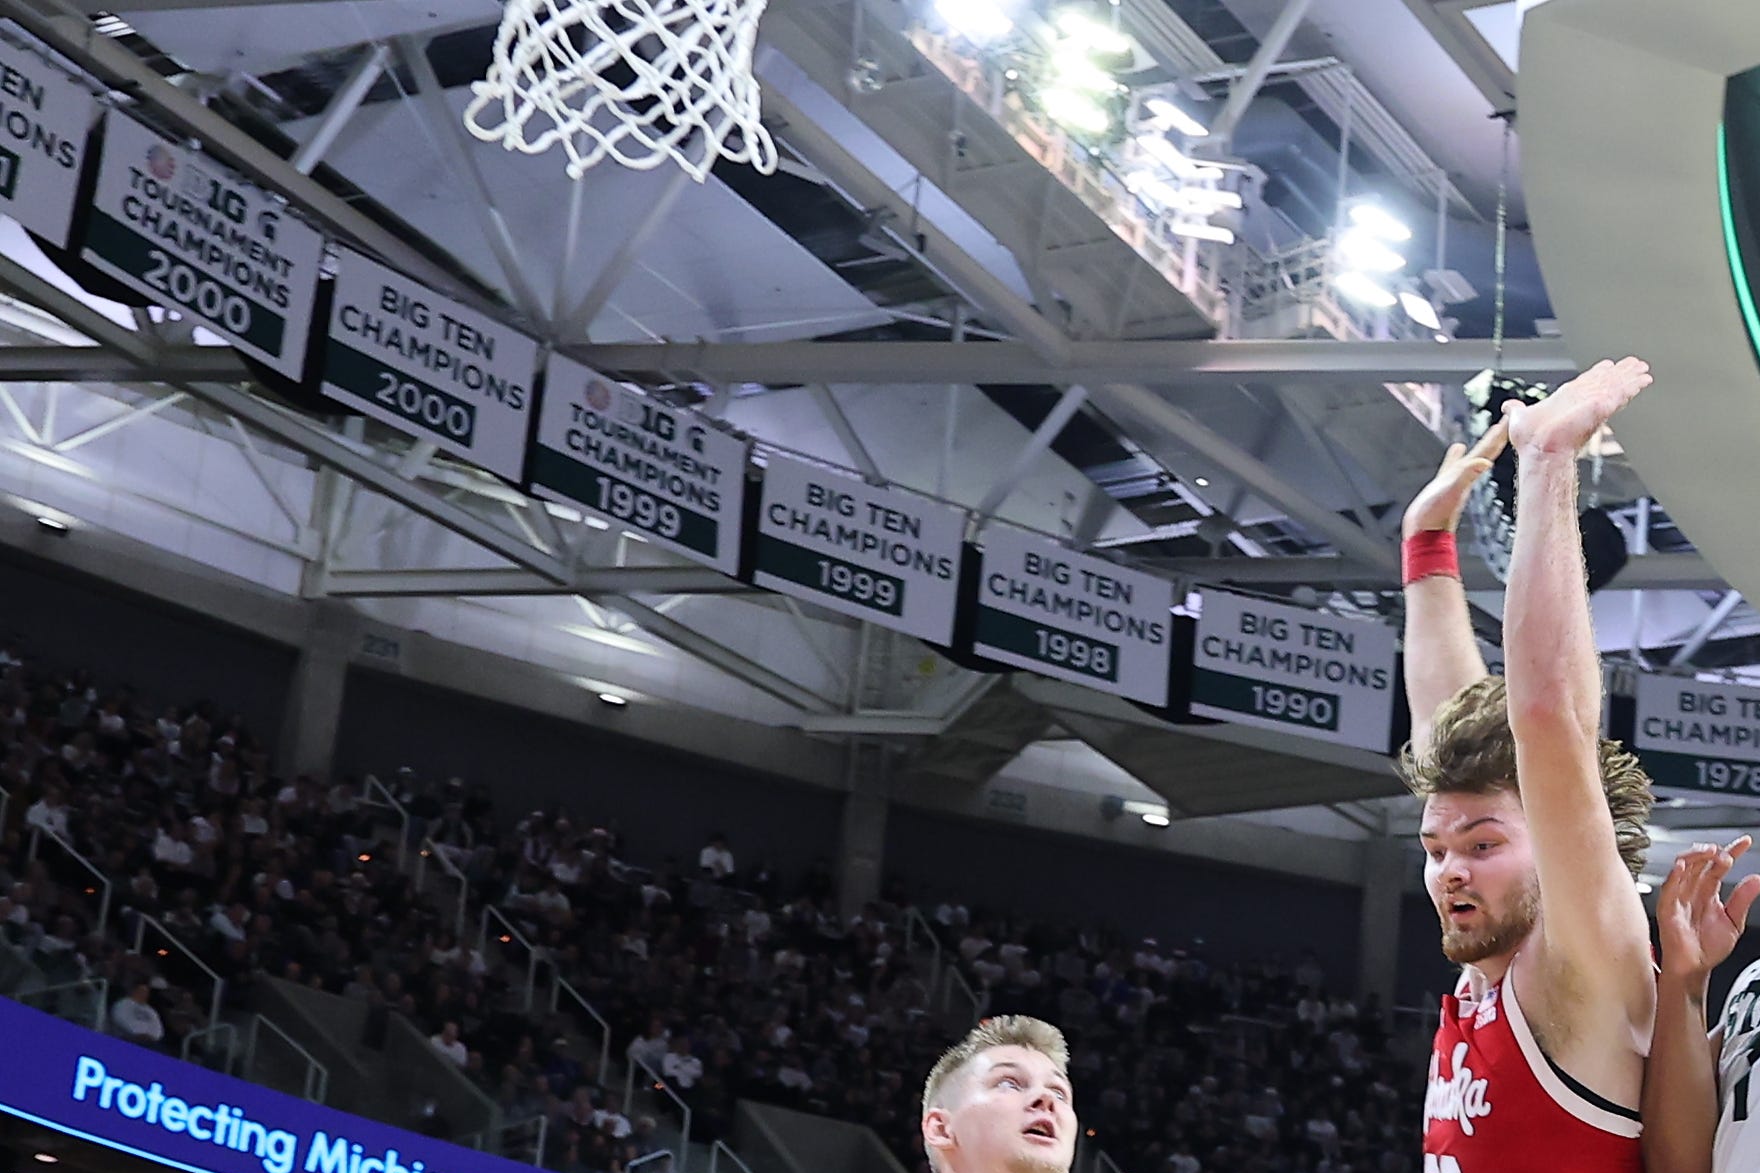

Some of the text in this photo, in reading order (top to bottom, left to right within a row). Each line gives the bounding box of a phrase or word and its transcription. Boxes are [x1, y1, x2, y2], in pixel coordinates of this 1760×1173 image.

[123, 195, 290, 309] CHAMPIONS
[128, 166, 295, 279] TOURNAMENT
[143, 250, 251, 334] 2000
[380, 285, 496, 362] BIG TEN
[340, 305, 524, 411] CHAMPIONS
[375, 372, 472, 437] 2000
[566, 428, 721, 513] CHAMPIONS
[570, 403, 722, 486] TOURNAMENT
[597, 475, 682, 539] 1999
[806, 483, 921, 539] BIG TEN
[768, 503, 953, 580] CHAMPIONS
[817, 560, 897, 607] 1999
[987, 573, 1164, 645] CHAMPIONS
[1025, 552, 1133, 604] BIG TEN
[1036, 629, 1112, 674] 1998
[1202, 635, 1388, 690] CHAMPIONS
[1240, 612, 1355, 653] BIG TEN
[1251, 685, 1334, 724] 1990
[1678, 692, 1727, 716] BIG
